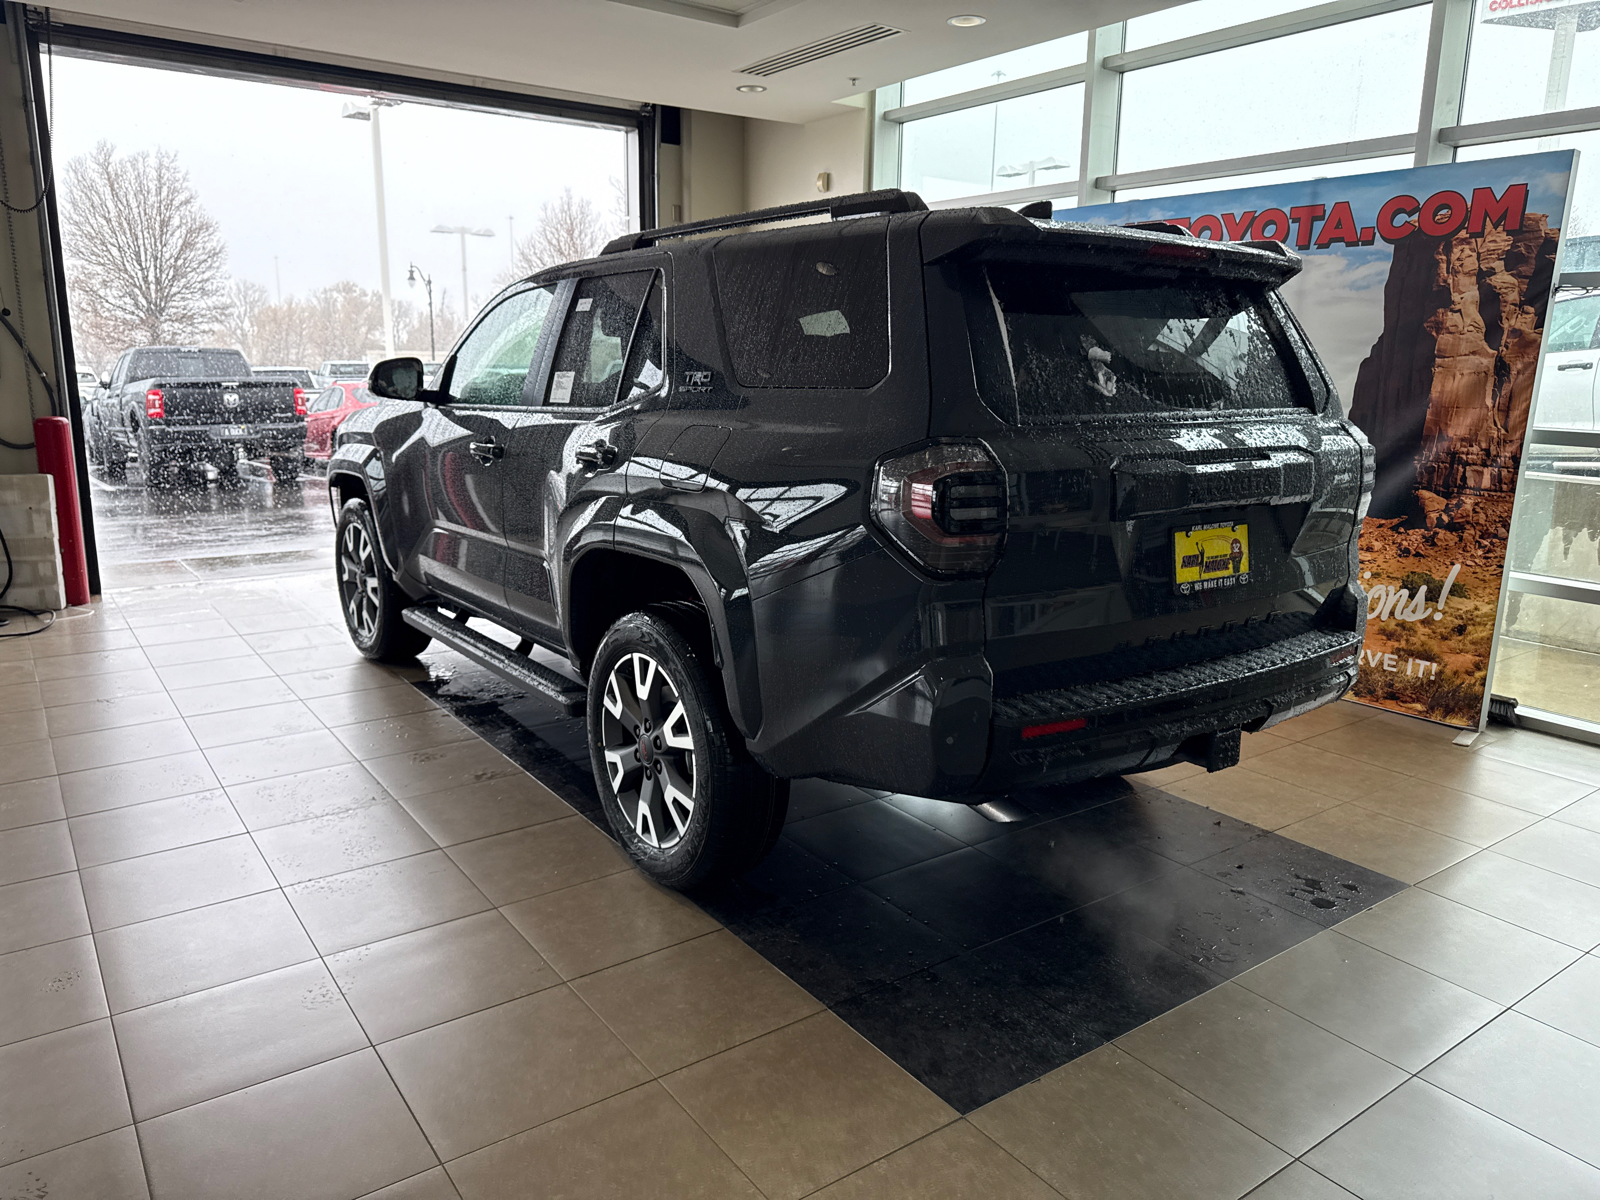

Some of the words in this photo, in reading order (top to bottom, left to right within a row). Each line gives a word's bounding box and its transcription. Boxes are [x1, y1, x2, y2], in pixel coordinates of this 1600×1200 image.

[684, 371, 712, 385] TRD
[678, 385, 713, 393] SPORT
[1232, 543, 1241, 552] 32
[1194, 581, 1202, 591] WE
[1203, 579, 1217, 589] MAKE
[1218, 578, 1223, 587] IT
[1224, 577, 1236, 587] EASY
[1360, 563, 1462, 622] ons!
[1406, 657, 1437, 681] IT!
